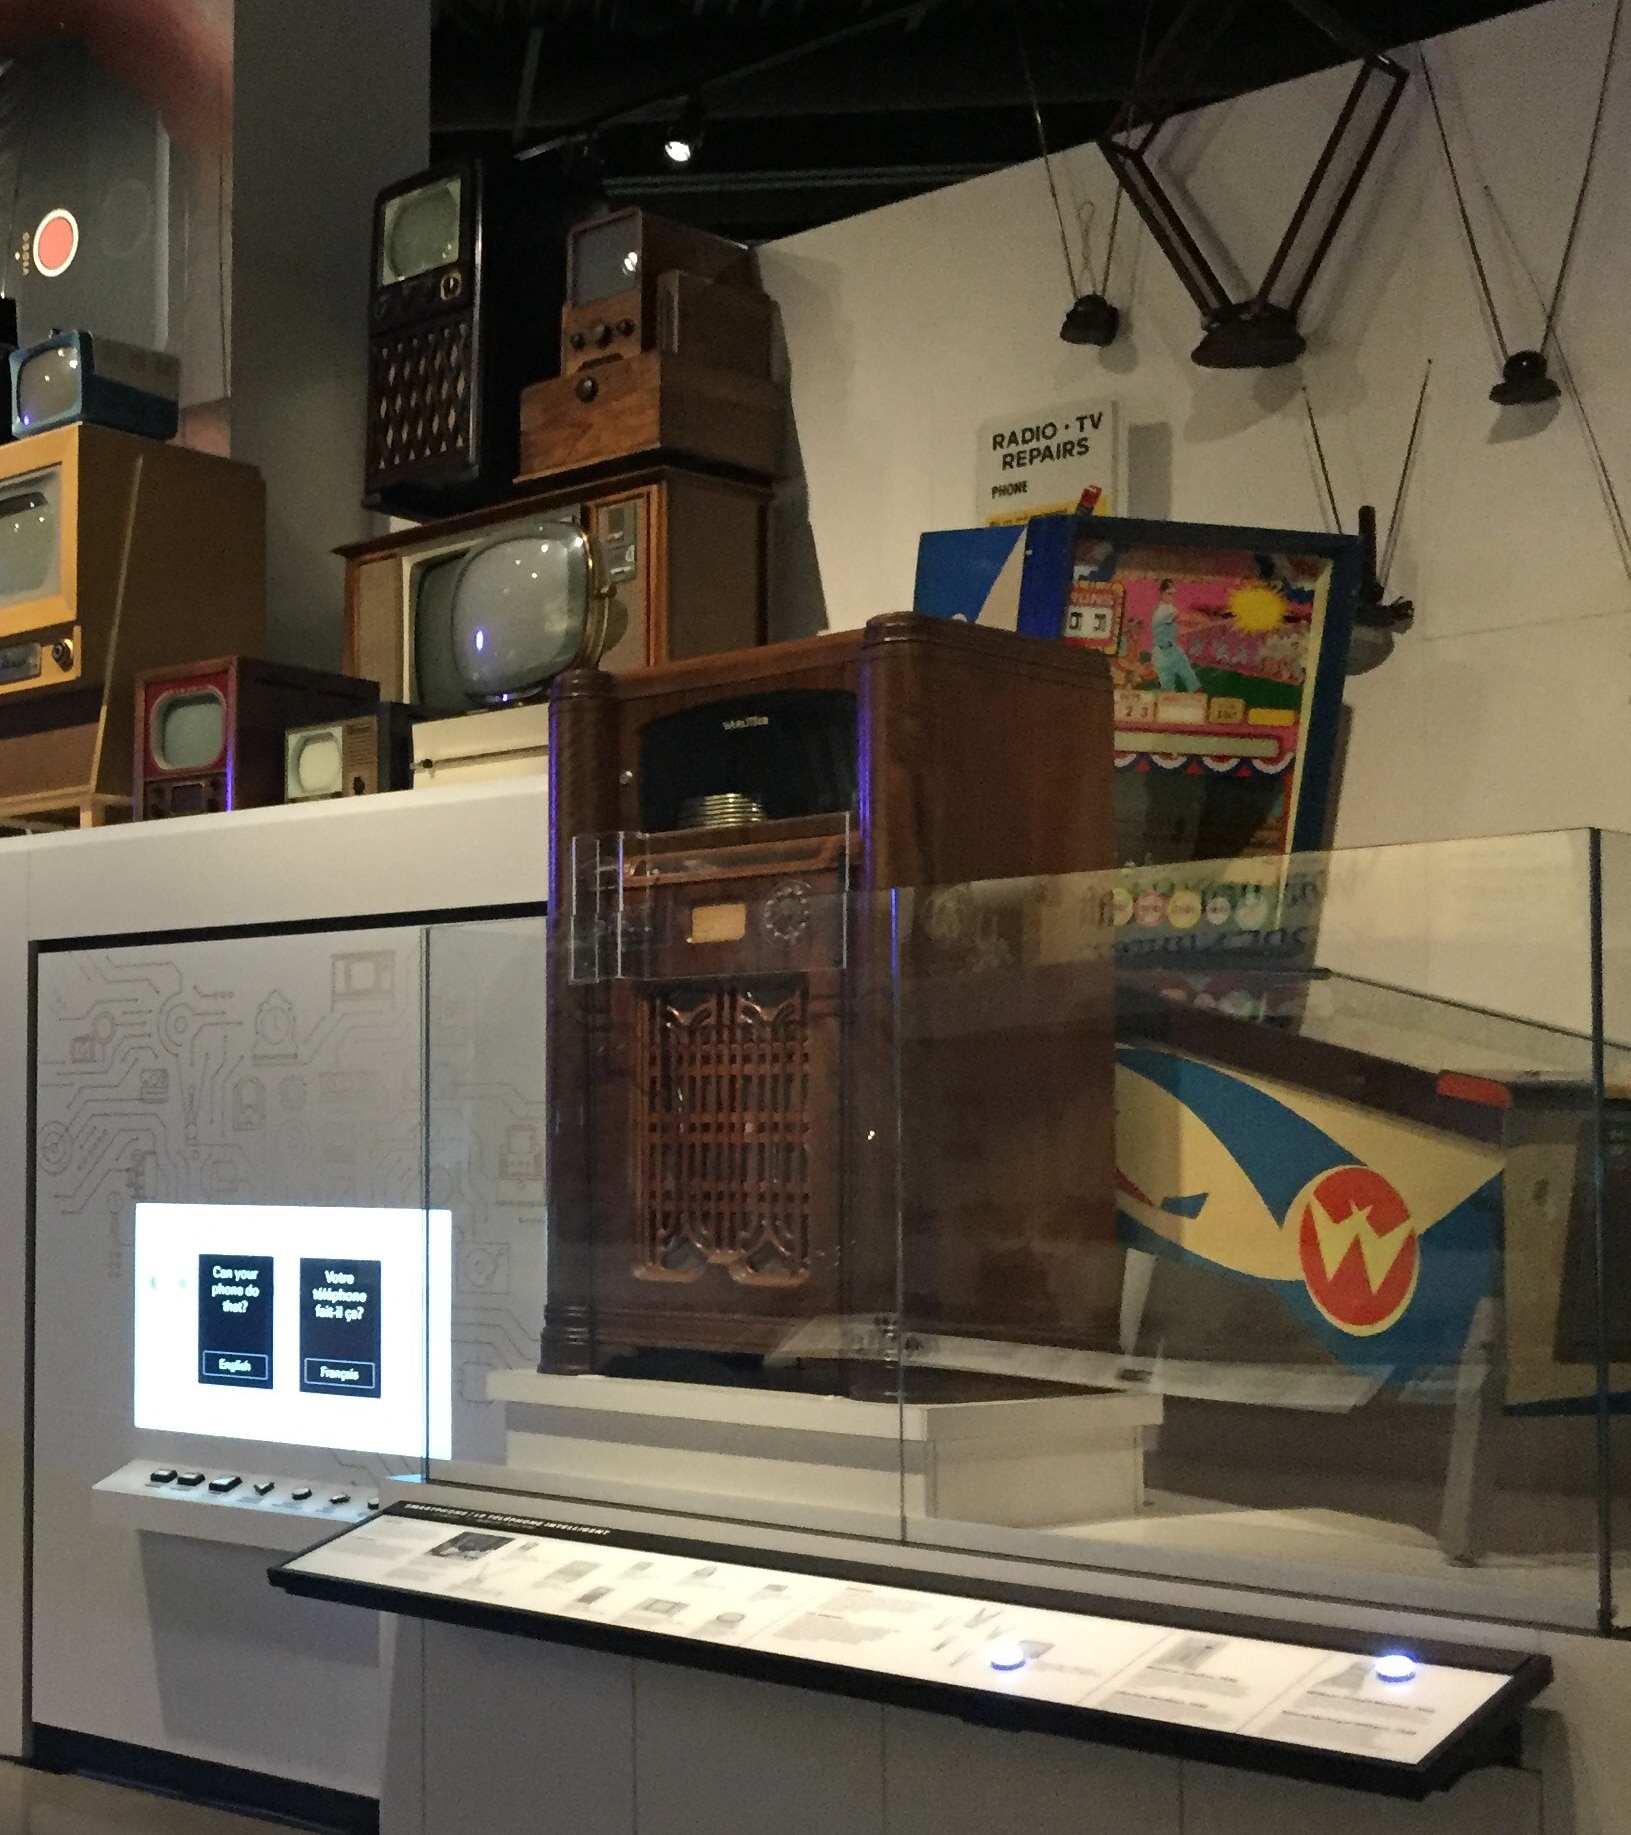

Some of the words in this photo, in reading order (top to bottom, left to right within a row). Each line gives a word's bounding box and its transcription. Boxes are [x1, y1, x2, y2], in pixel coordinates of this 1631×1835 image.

[992, 422, 1057, 451] RADIO
[1076, 411, 1103, 433] TV
[1002, 437, 1090, 471] REPAIRS
[991, 480, 1028, 499] PHONE
[213, 1265, 233, 1279] Can
[234, 1269, 259, 1281] your
[325, 1270, 355, 1284] Votre
[211, 1283, 244, 1297] phone
[245, 1283, 260, 1297] do
[312, 1287, 367, 1303] téléphone
[222, 1300, 249, 1313] that?
[218, 1357, 252, 1374] English
[320, 1365, 360, 1383] Français
